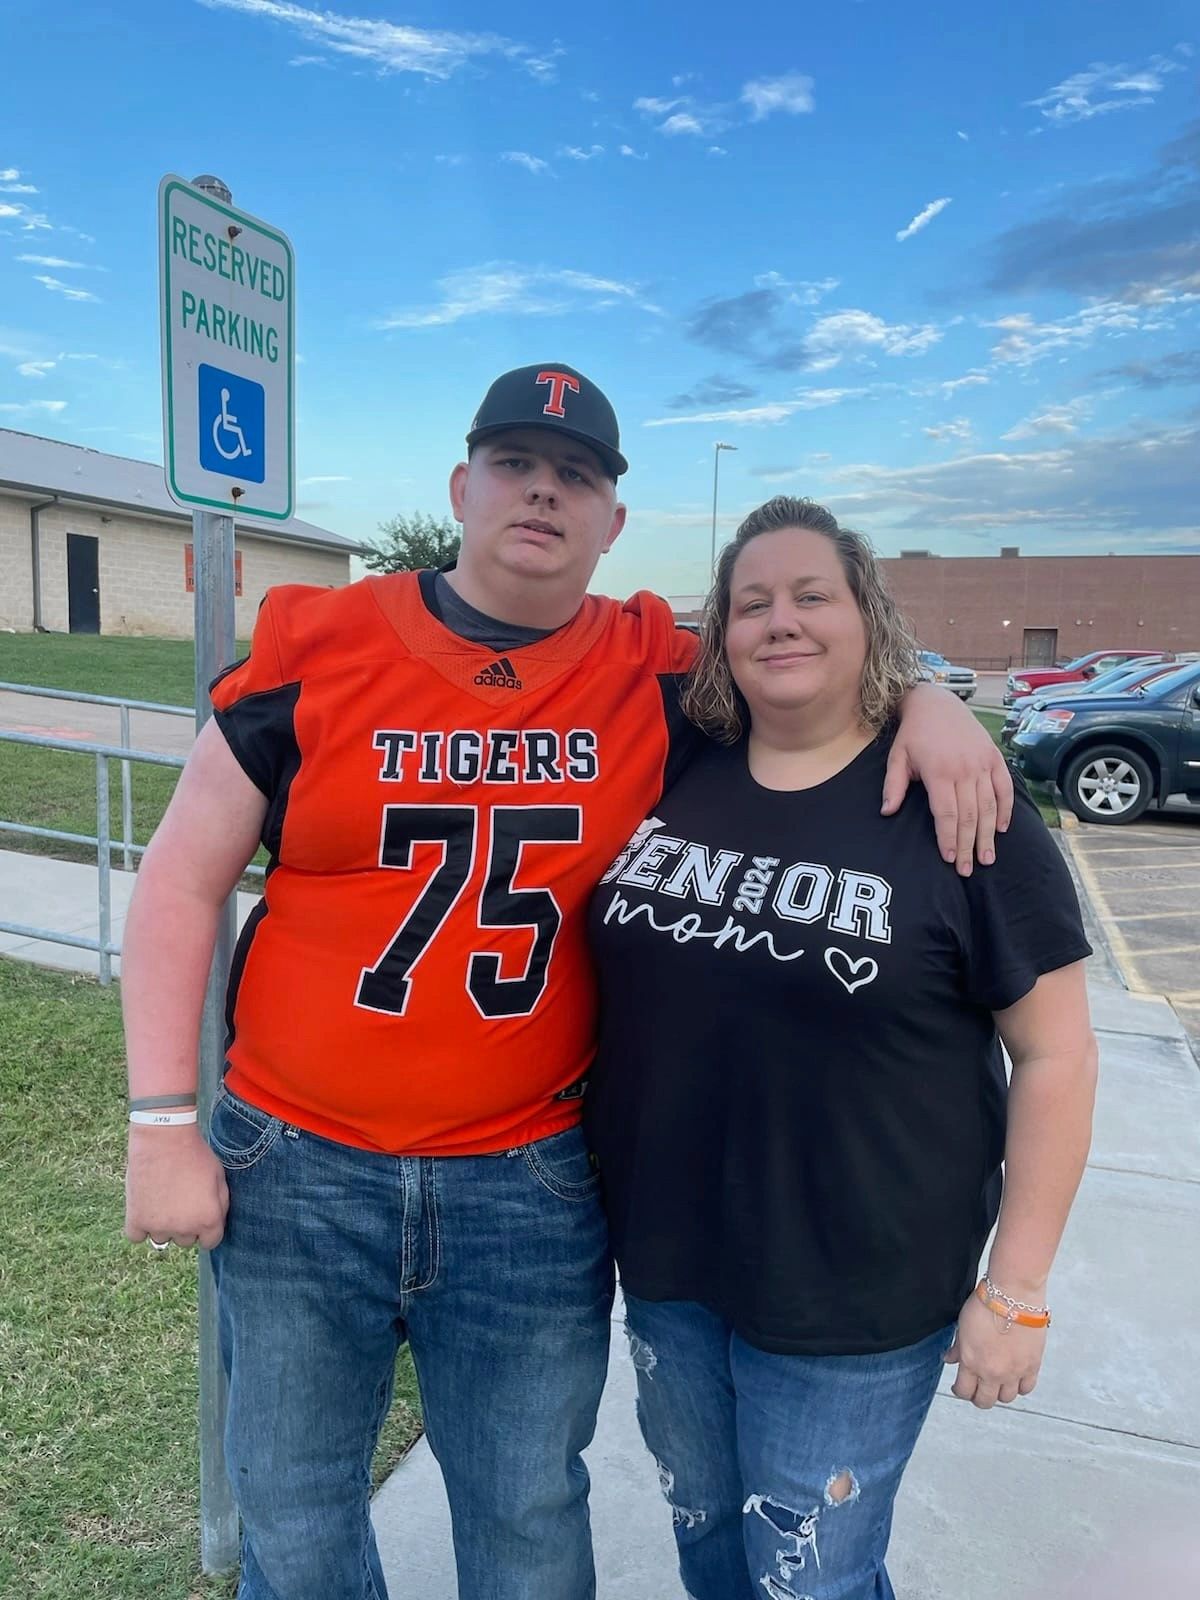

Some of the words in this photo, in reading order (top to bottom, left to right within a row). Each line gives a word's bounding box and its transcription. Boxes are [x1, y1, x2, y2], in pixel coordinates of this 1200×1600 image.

[172, 215, 285, 302] RESERVED
[181, 290, 278, 363] PARKING
[535, 371, 580, 418] T
[474, 673, 522, 690] adidas
[372, 728, 600, 785] TIGERS
[353, 803, 583, 1020] 75
[732, 855, 781, 915] 2024
[602, 889, 805, 962] mom
